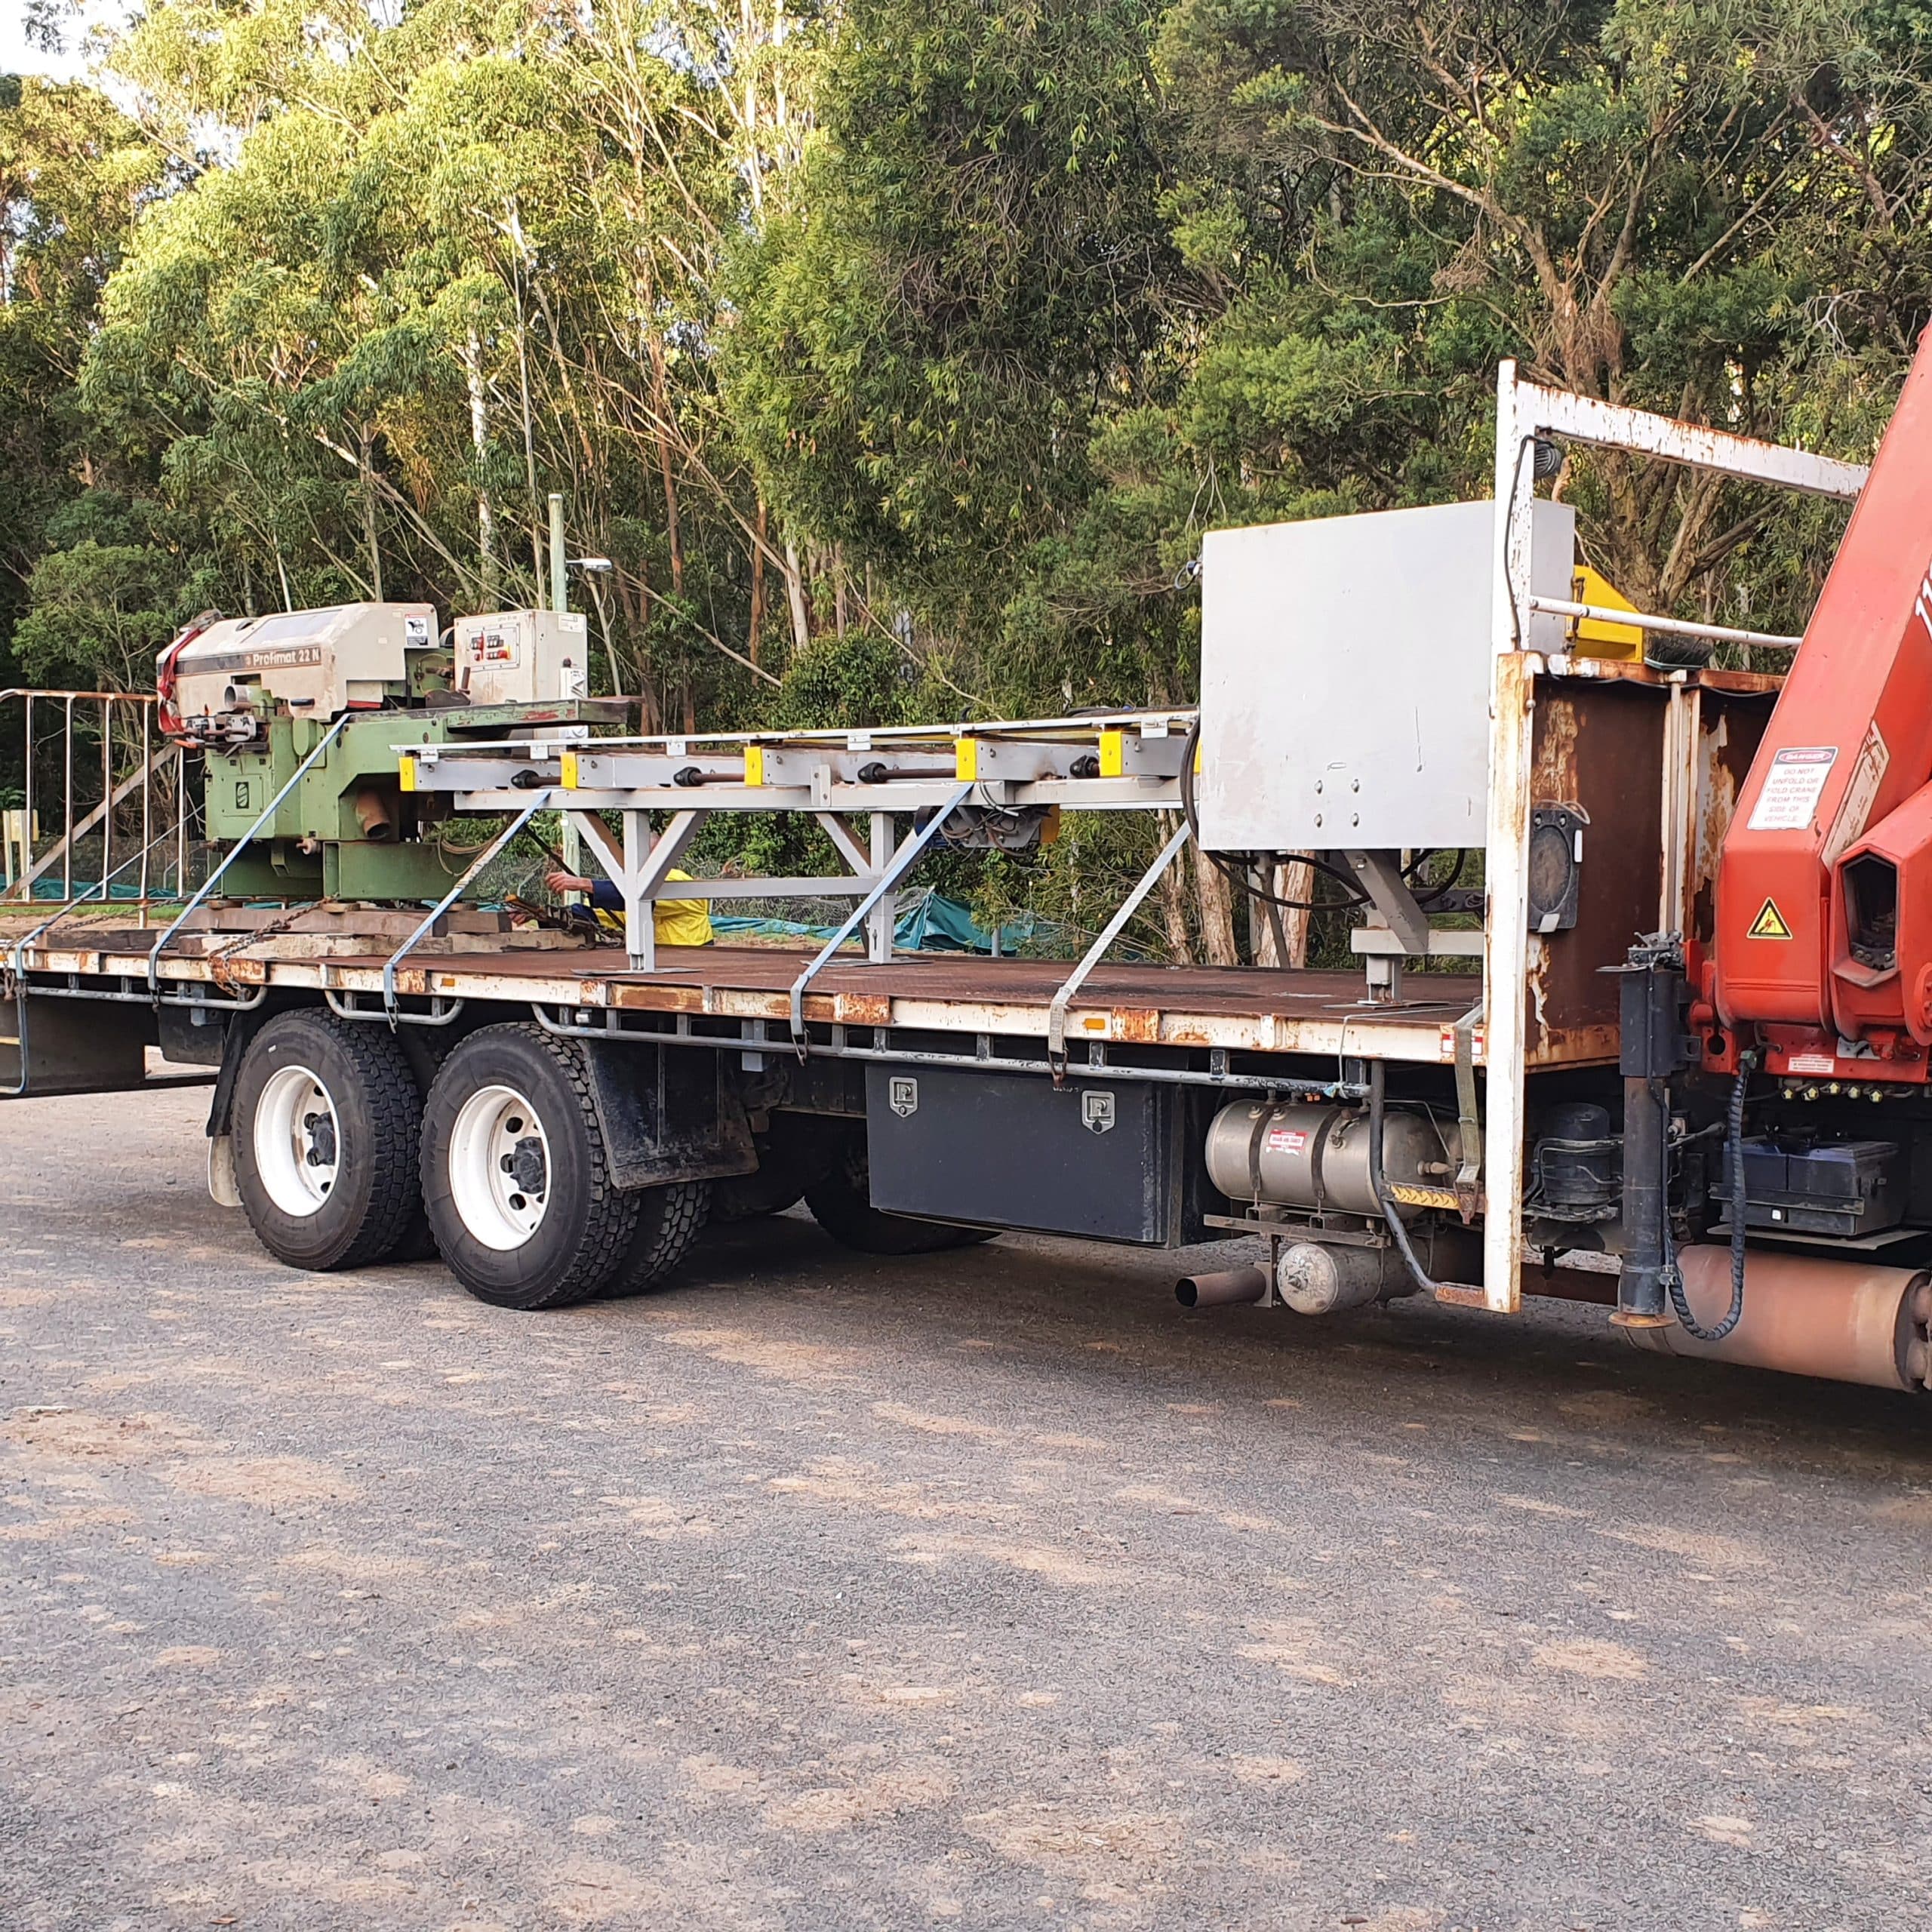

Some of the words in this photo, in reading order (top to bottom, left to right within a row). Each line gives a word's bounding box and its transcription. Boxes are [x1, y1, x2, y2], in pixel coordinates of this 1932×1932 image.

[252, 651, 297, 666] Profimat
[298, 649, 311, 663] 22
[312, 648, 319, 661] N
